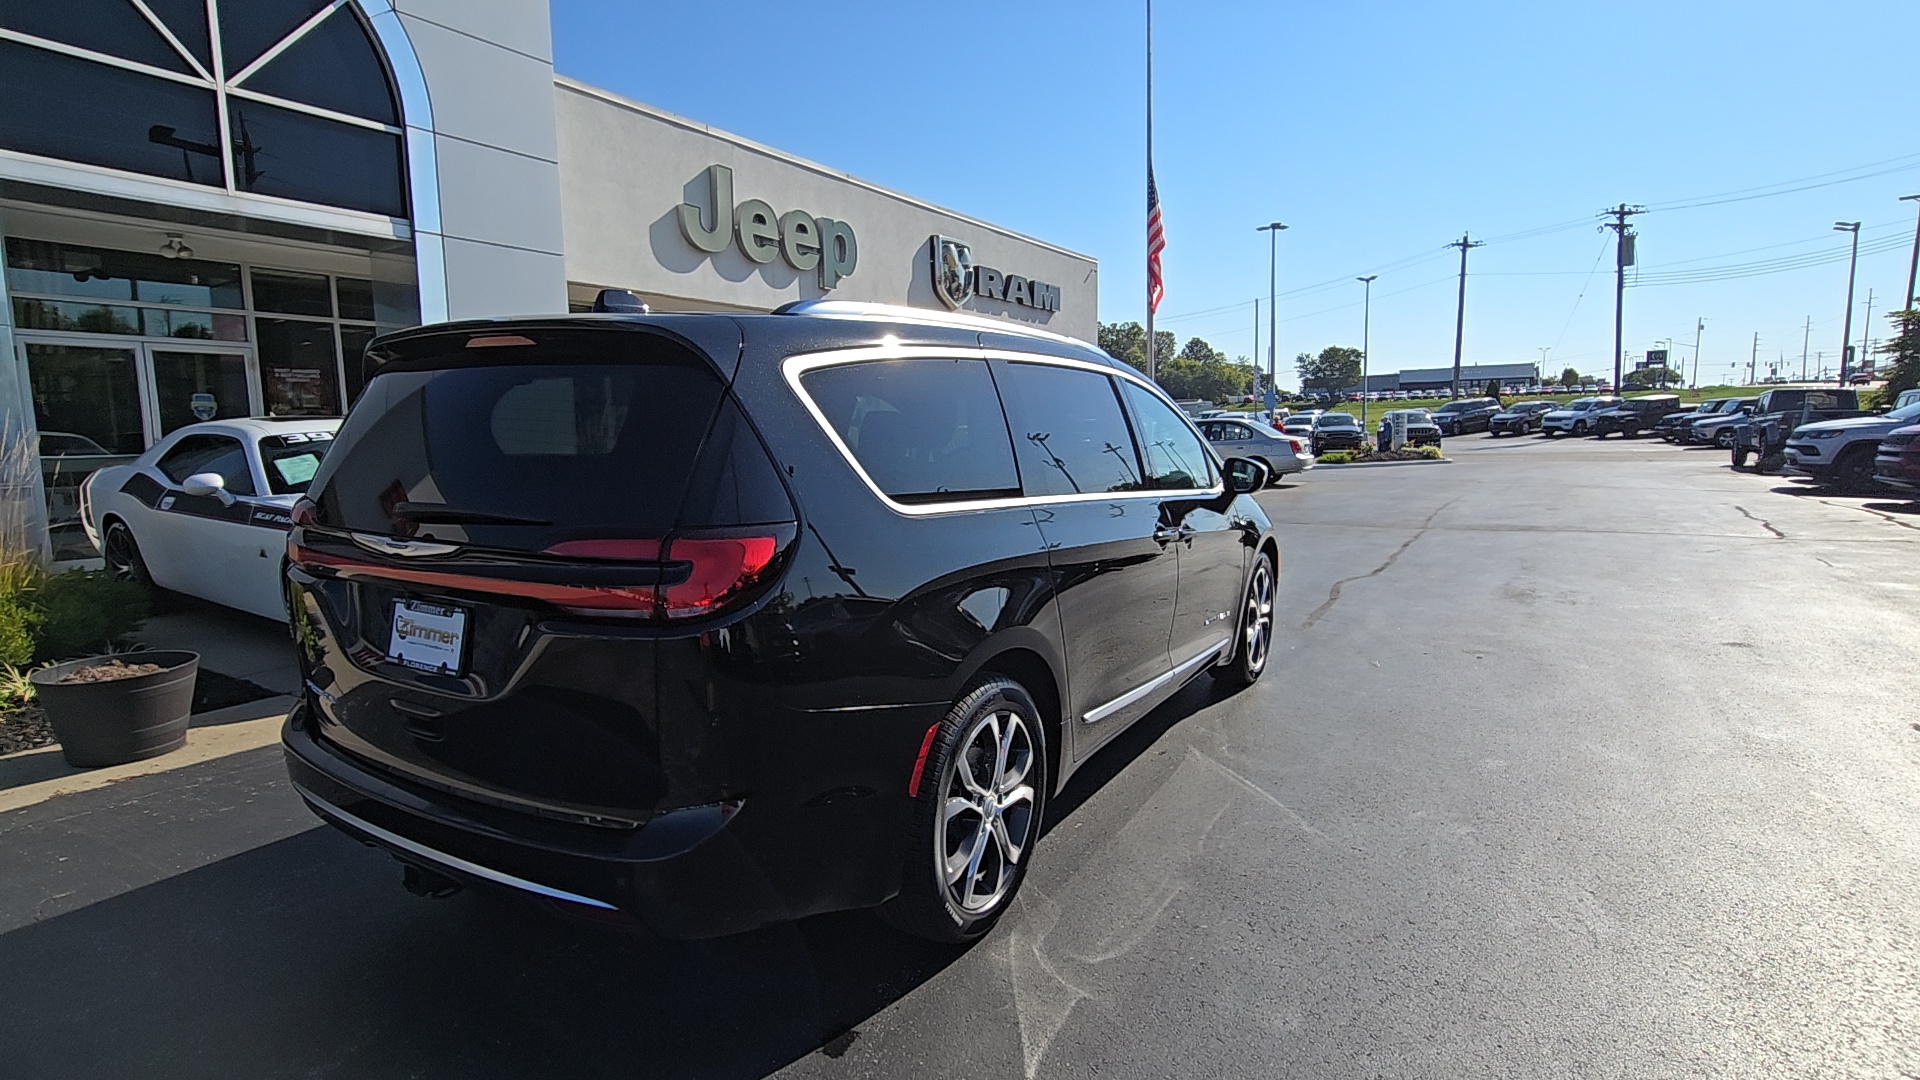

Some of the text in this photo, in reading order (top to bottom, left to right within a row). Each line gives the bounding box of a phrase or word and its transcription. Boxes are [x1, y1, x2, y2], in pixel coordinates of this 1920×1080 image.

[677, 164, 857, 290] Jeep
[974, 265, 1061, 312] RAM
[396, 616, 459, 645] Zimmer
[403, 660, 438, 672] FLORENCE
